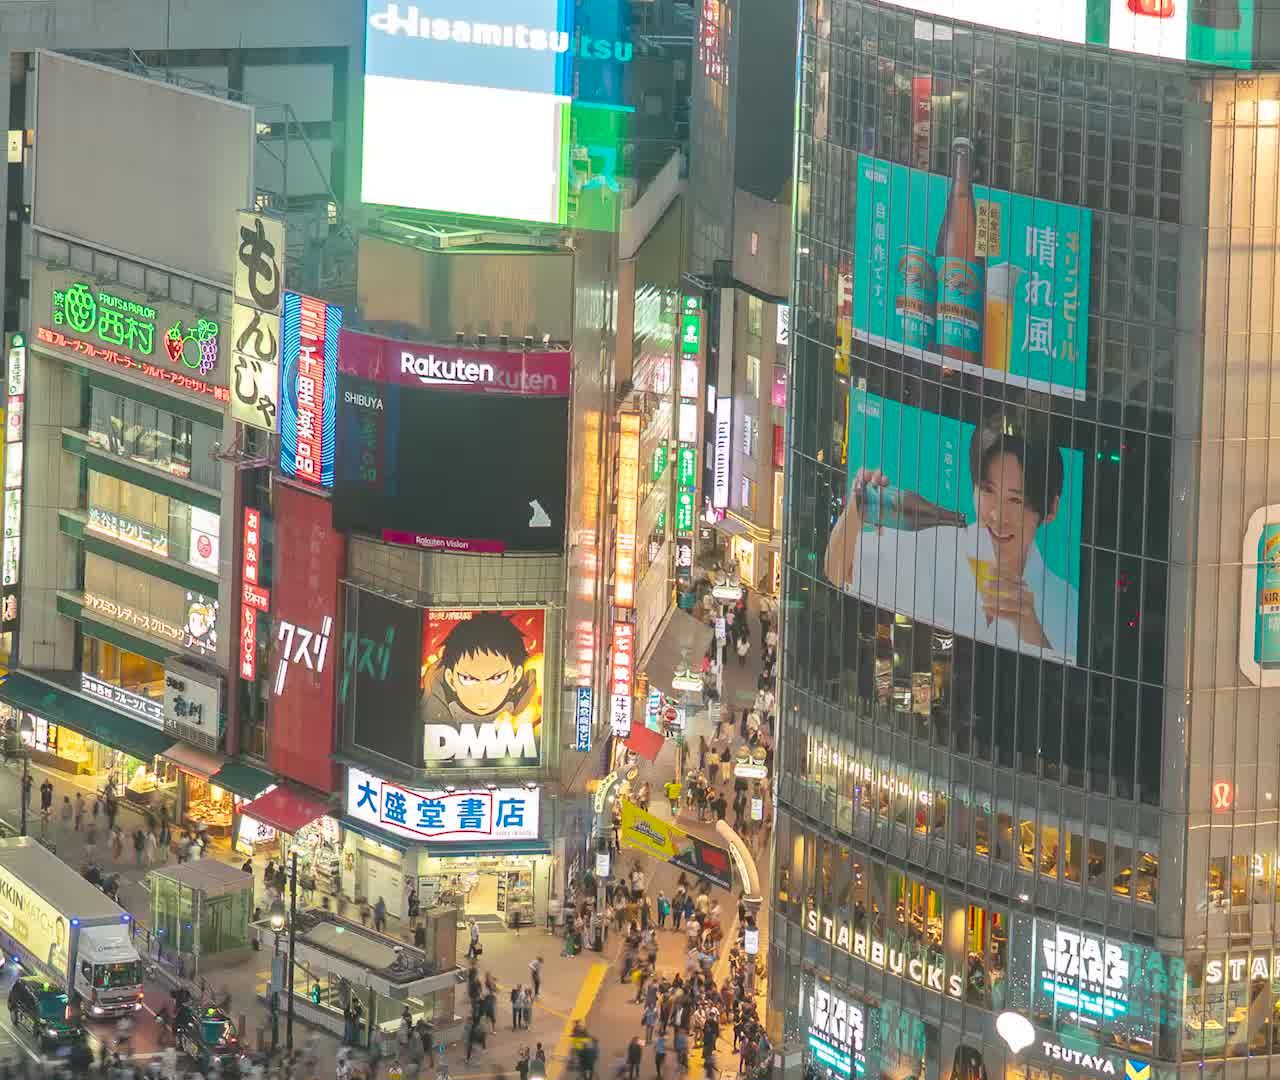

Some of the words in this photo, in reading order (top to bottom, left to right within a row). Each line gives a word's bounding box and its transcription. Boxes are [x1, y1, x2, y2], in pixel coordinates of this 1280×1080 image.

[1021, 225, 1060, 361] 晴れ風
[98, 306, 154, 355] 西村
[235, 217, 280, 428] もんじゃ
[400, 351, 494, 386] Rakuten
[344, 390, 385, 412] SHIBUYA
[415, 535, 445, 550] Rakuten
[445, 538, 470, 551] Vision
[273, 615, 334, 696] クスリ
[423, 720, 537, 762] DMM
[356, 780, 527, 830] 大盛堂書店
[808, 909, 963, 998] STARBUCKS
[1042, 928, 1123, 968] STAR
[1043, 951, 1129, 990] WARS
[1043, 1041, 1116, 1075] TSUTAYA
